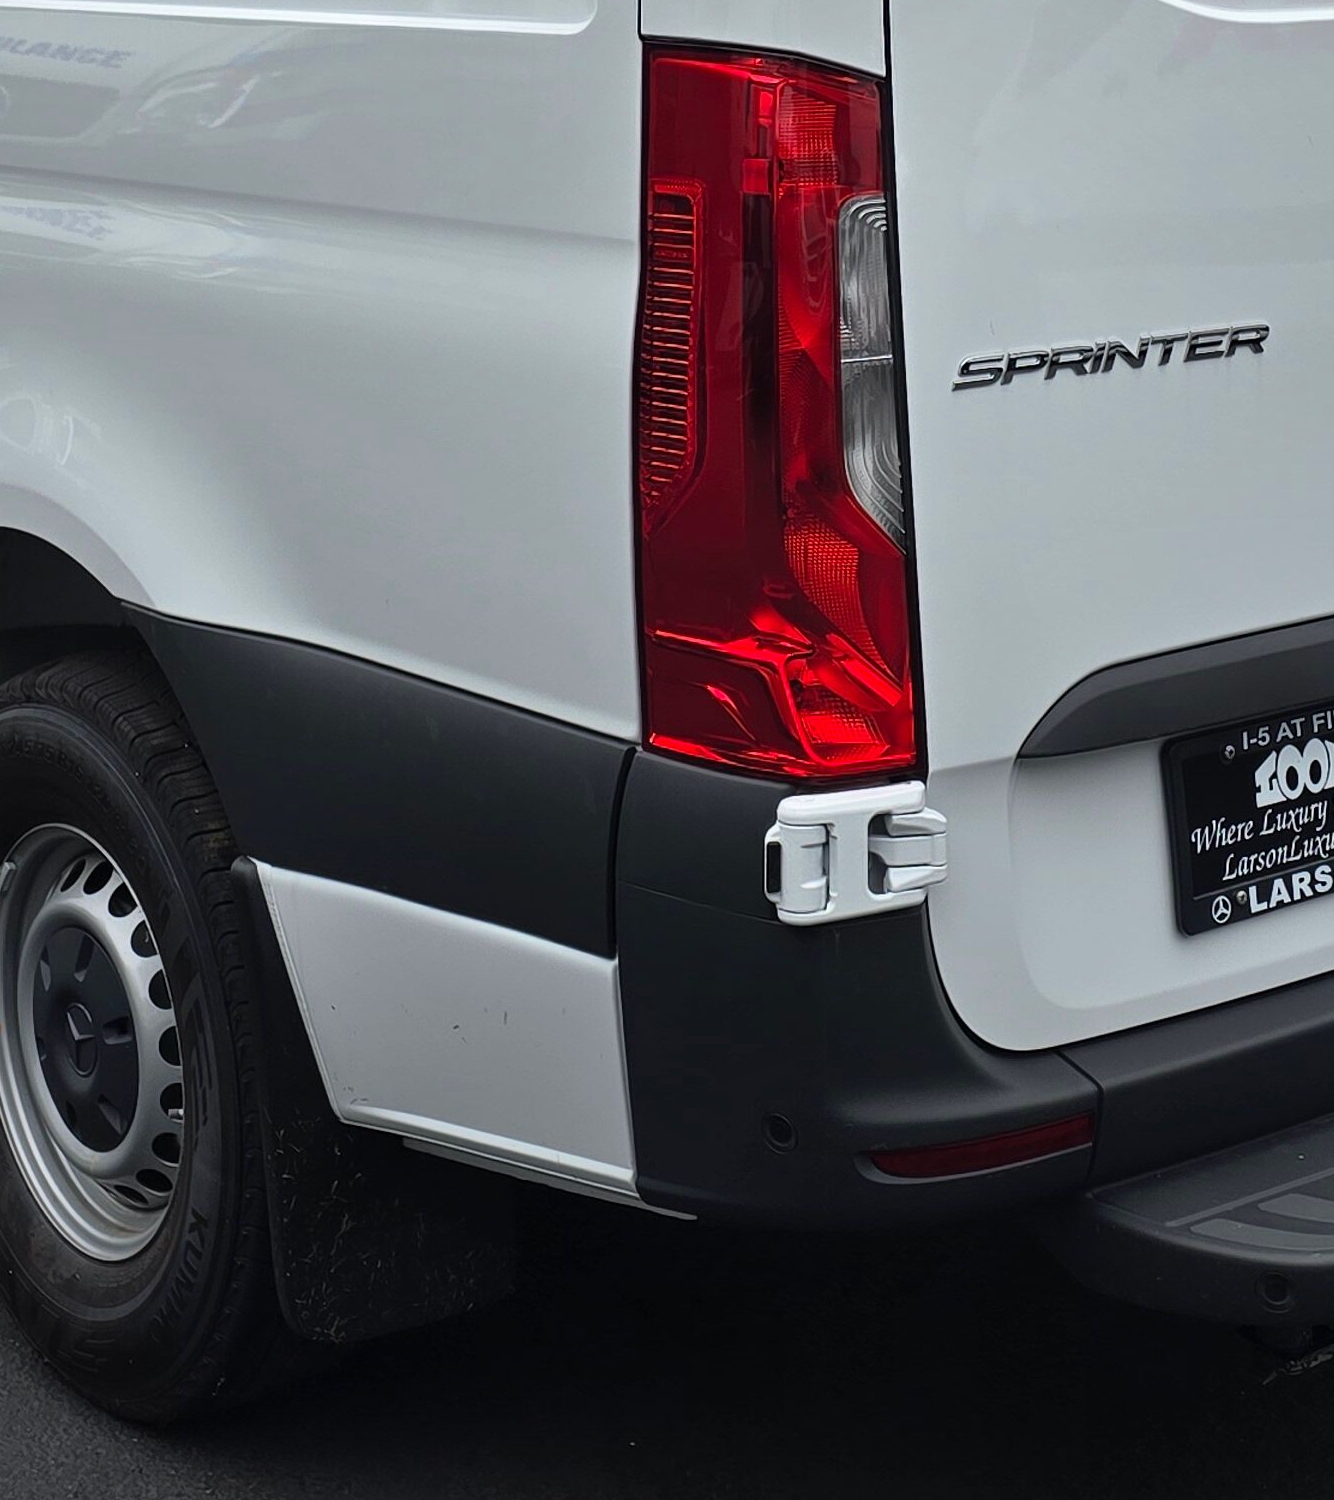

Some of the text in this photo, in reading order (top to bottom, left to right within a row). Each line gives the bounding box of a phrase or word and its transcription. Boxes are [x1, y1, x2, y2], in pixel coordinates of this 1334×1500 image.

[950, 322, 1270, 392] SPRINTER
[1242, 726, 1271, 750] I-5
[1276, 717, 1306, 742] AT
[1190, 817, 1254, 854] Where
[1259, 800, 1328, 836] Luxury
